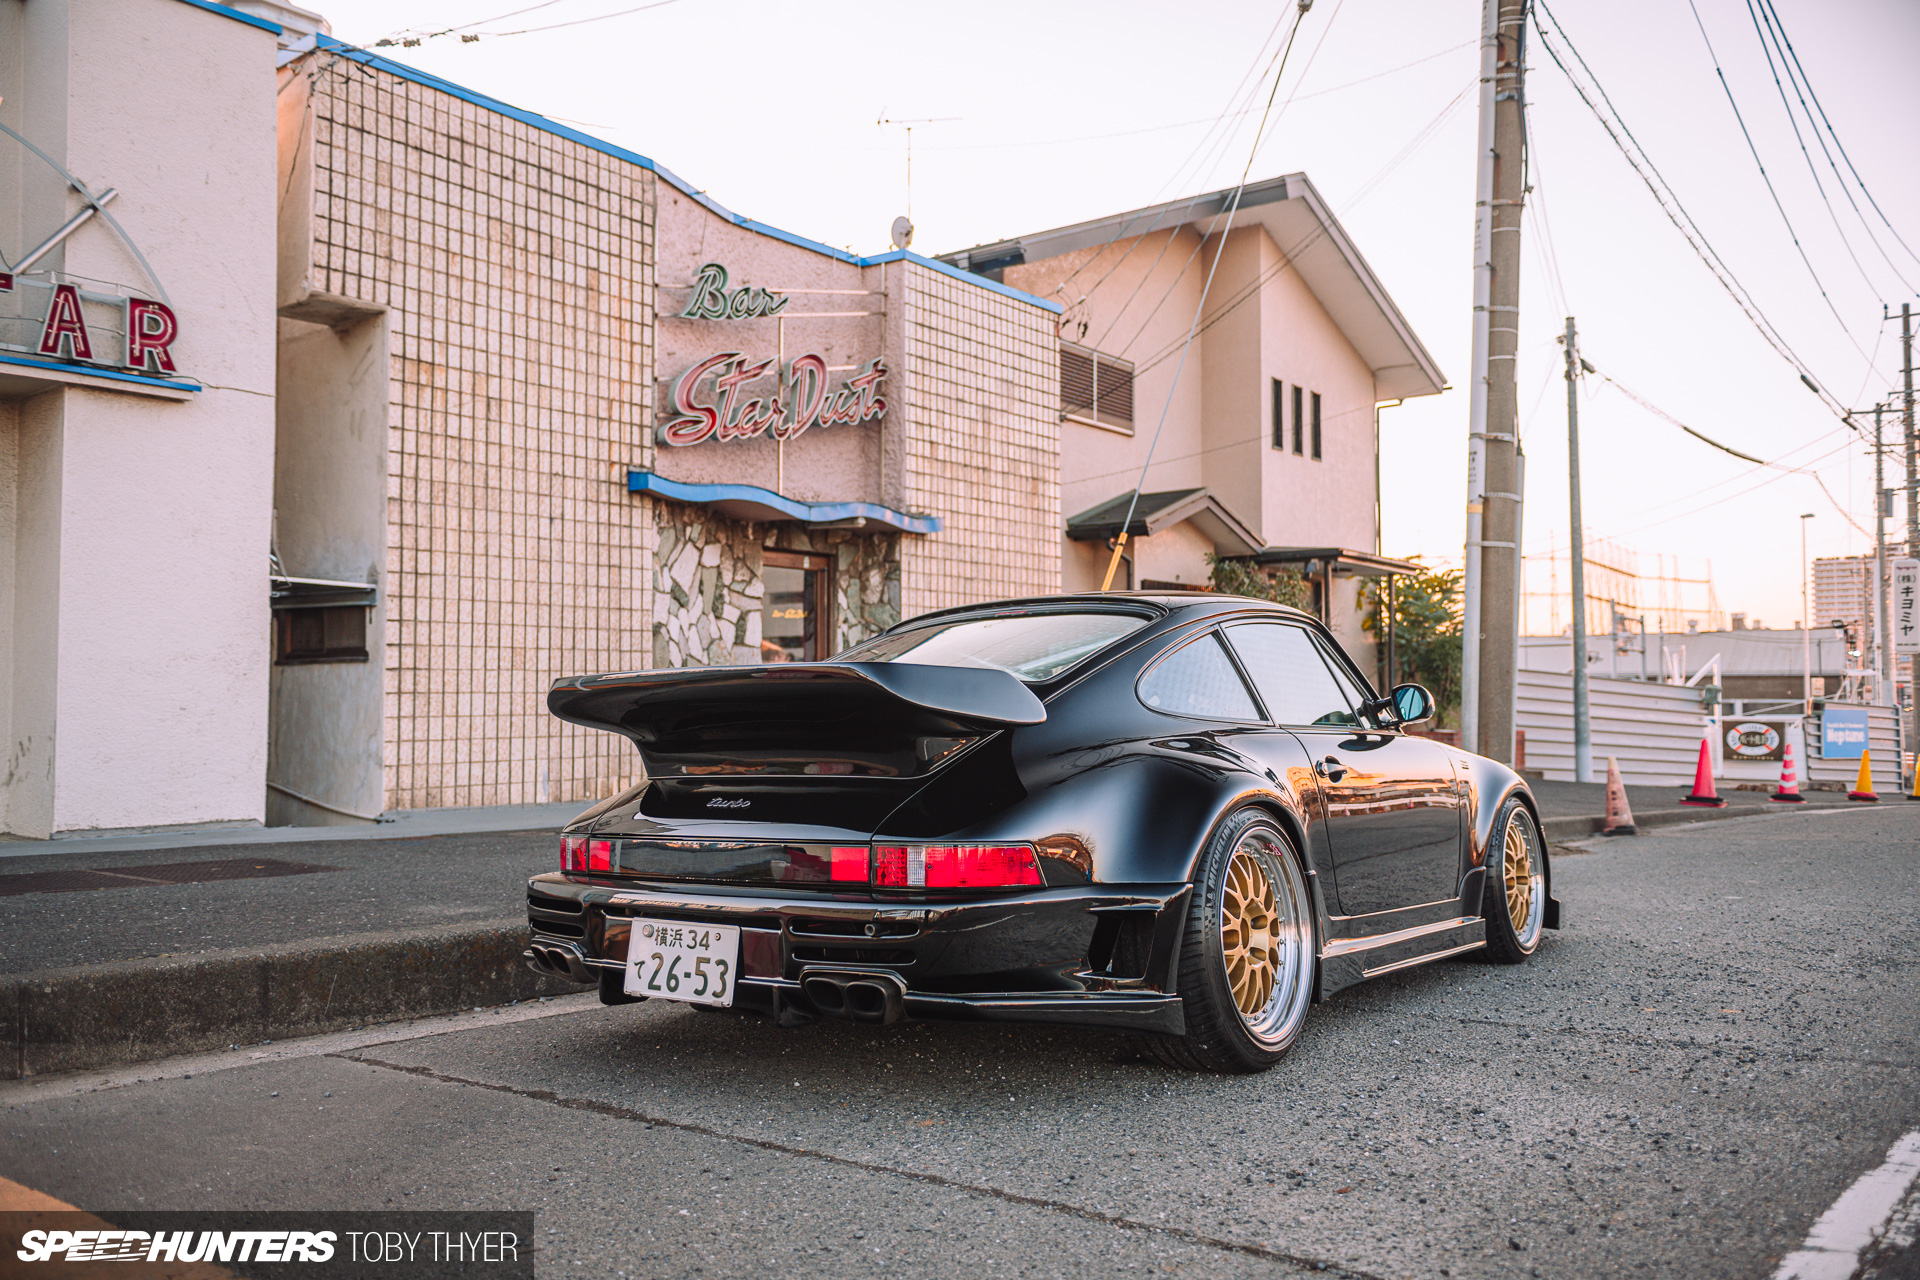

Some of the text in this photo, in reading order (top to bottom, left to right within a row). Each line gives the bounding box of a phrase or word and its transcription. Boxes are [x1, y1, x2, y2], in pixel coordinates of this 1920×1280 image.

[683, 262, 790, 321] Bar
[0, 271, 178, 374] AR
[1826, 728, 1866, 746] Neptune
[1208, 824, 1233, 889] MICHELIN
[655, 926, 710, 951] 横浜 34
[633, 952, 729, 998] て 26-53
